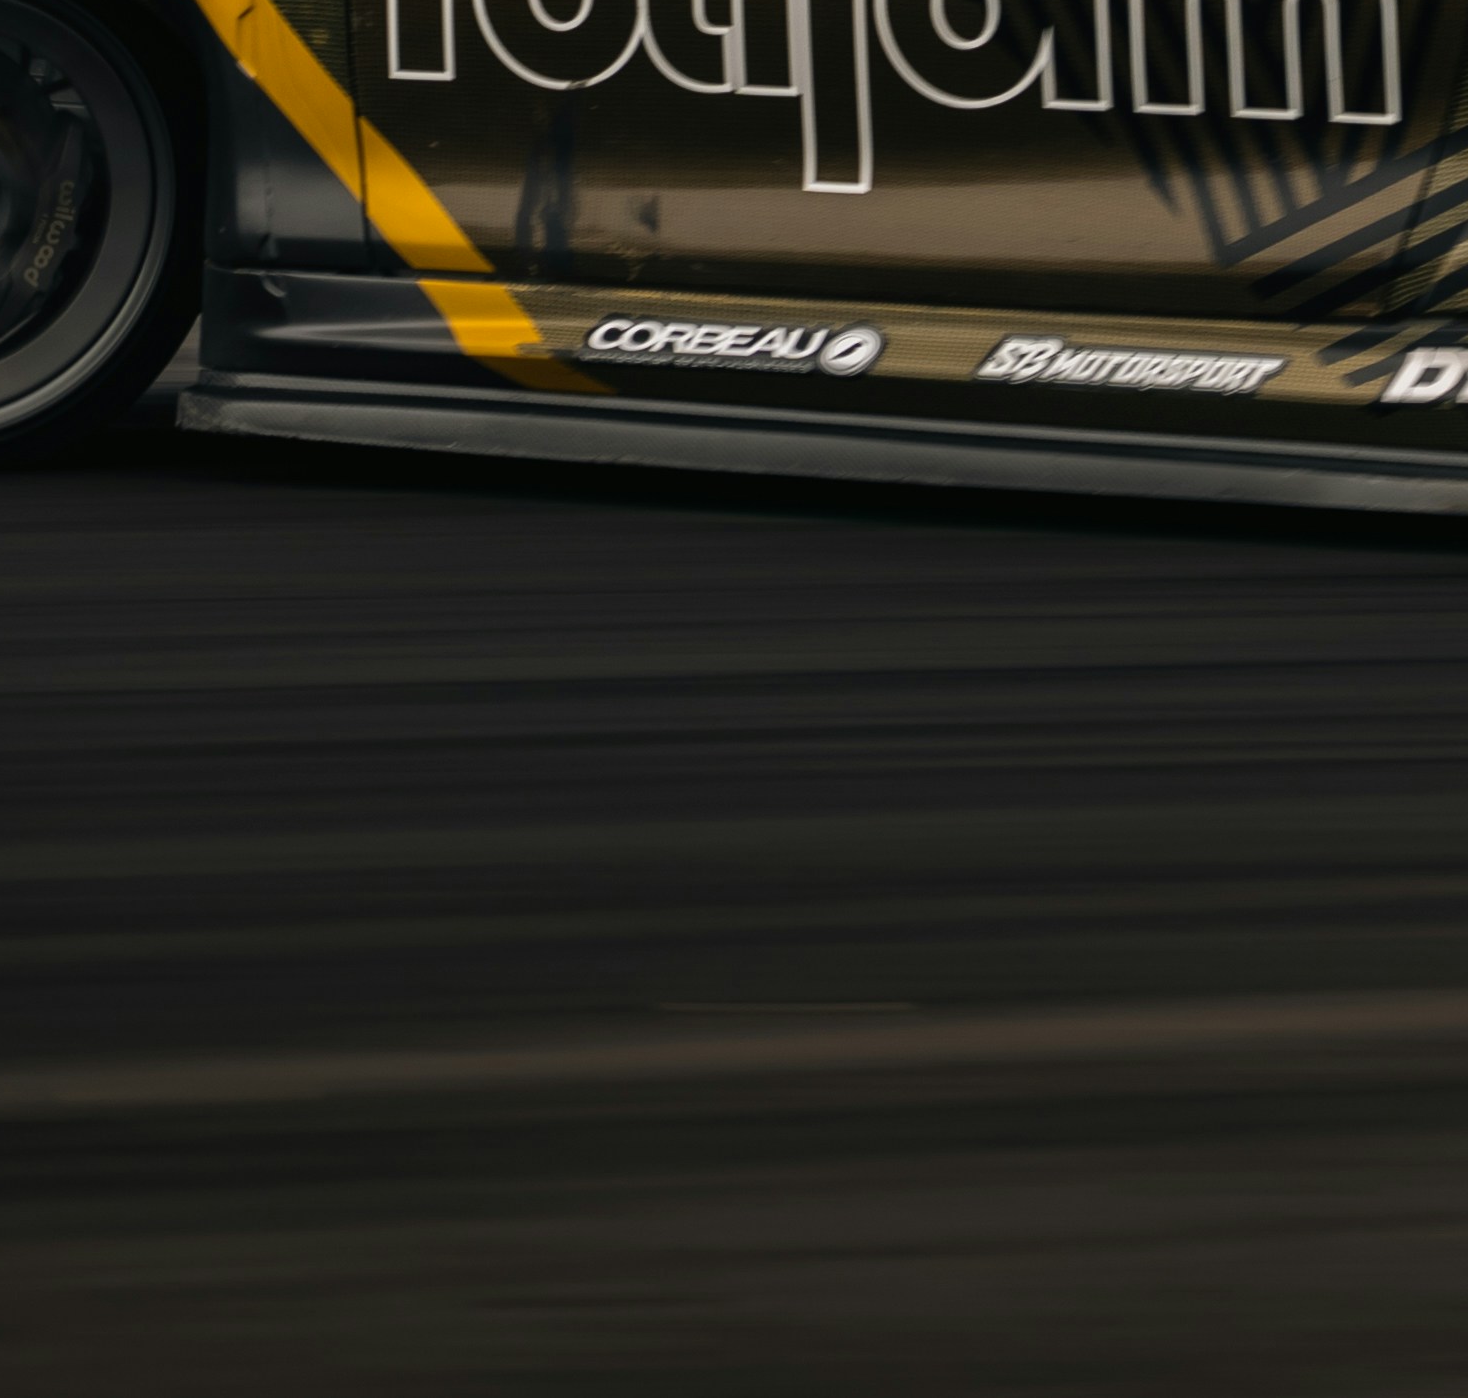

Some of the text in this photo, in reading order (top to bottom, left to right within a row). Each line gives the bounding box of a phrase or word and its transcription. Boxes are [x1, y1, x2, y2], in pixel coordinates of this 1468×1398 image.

[23, 180, 77, 288] wilwood
[587, 317, 830, 360] CORBEAU
[1048, 351, 1287, 396] MOTORSPORT
